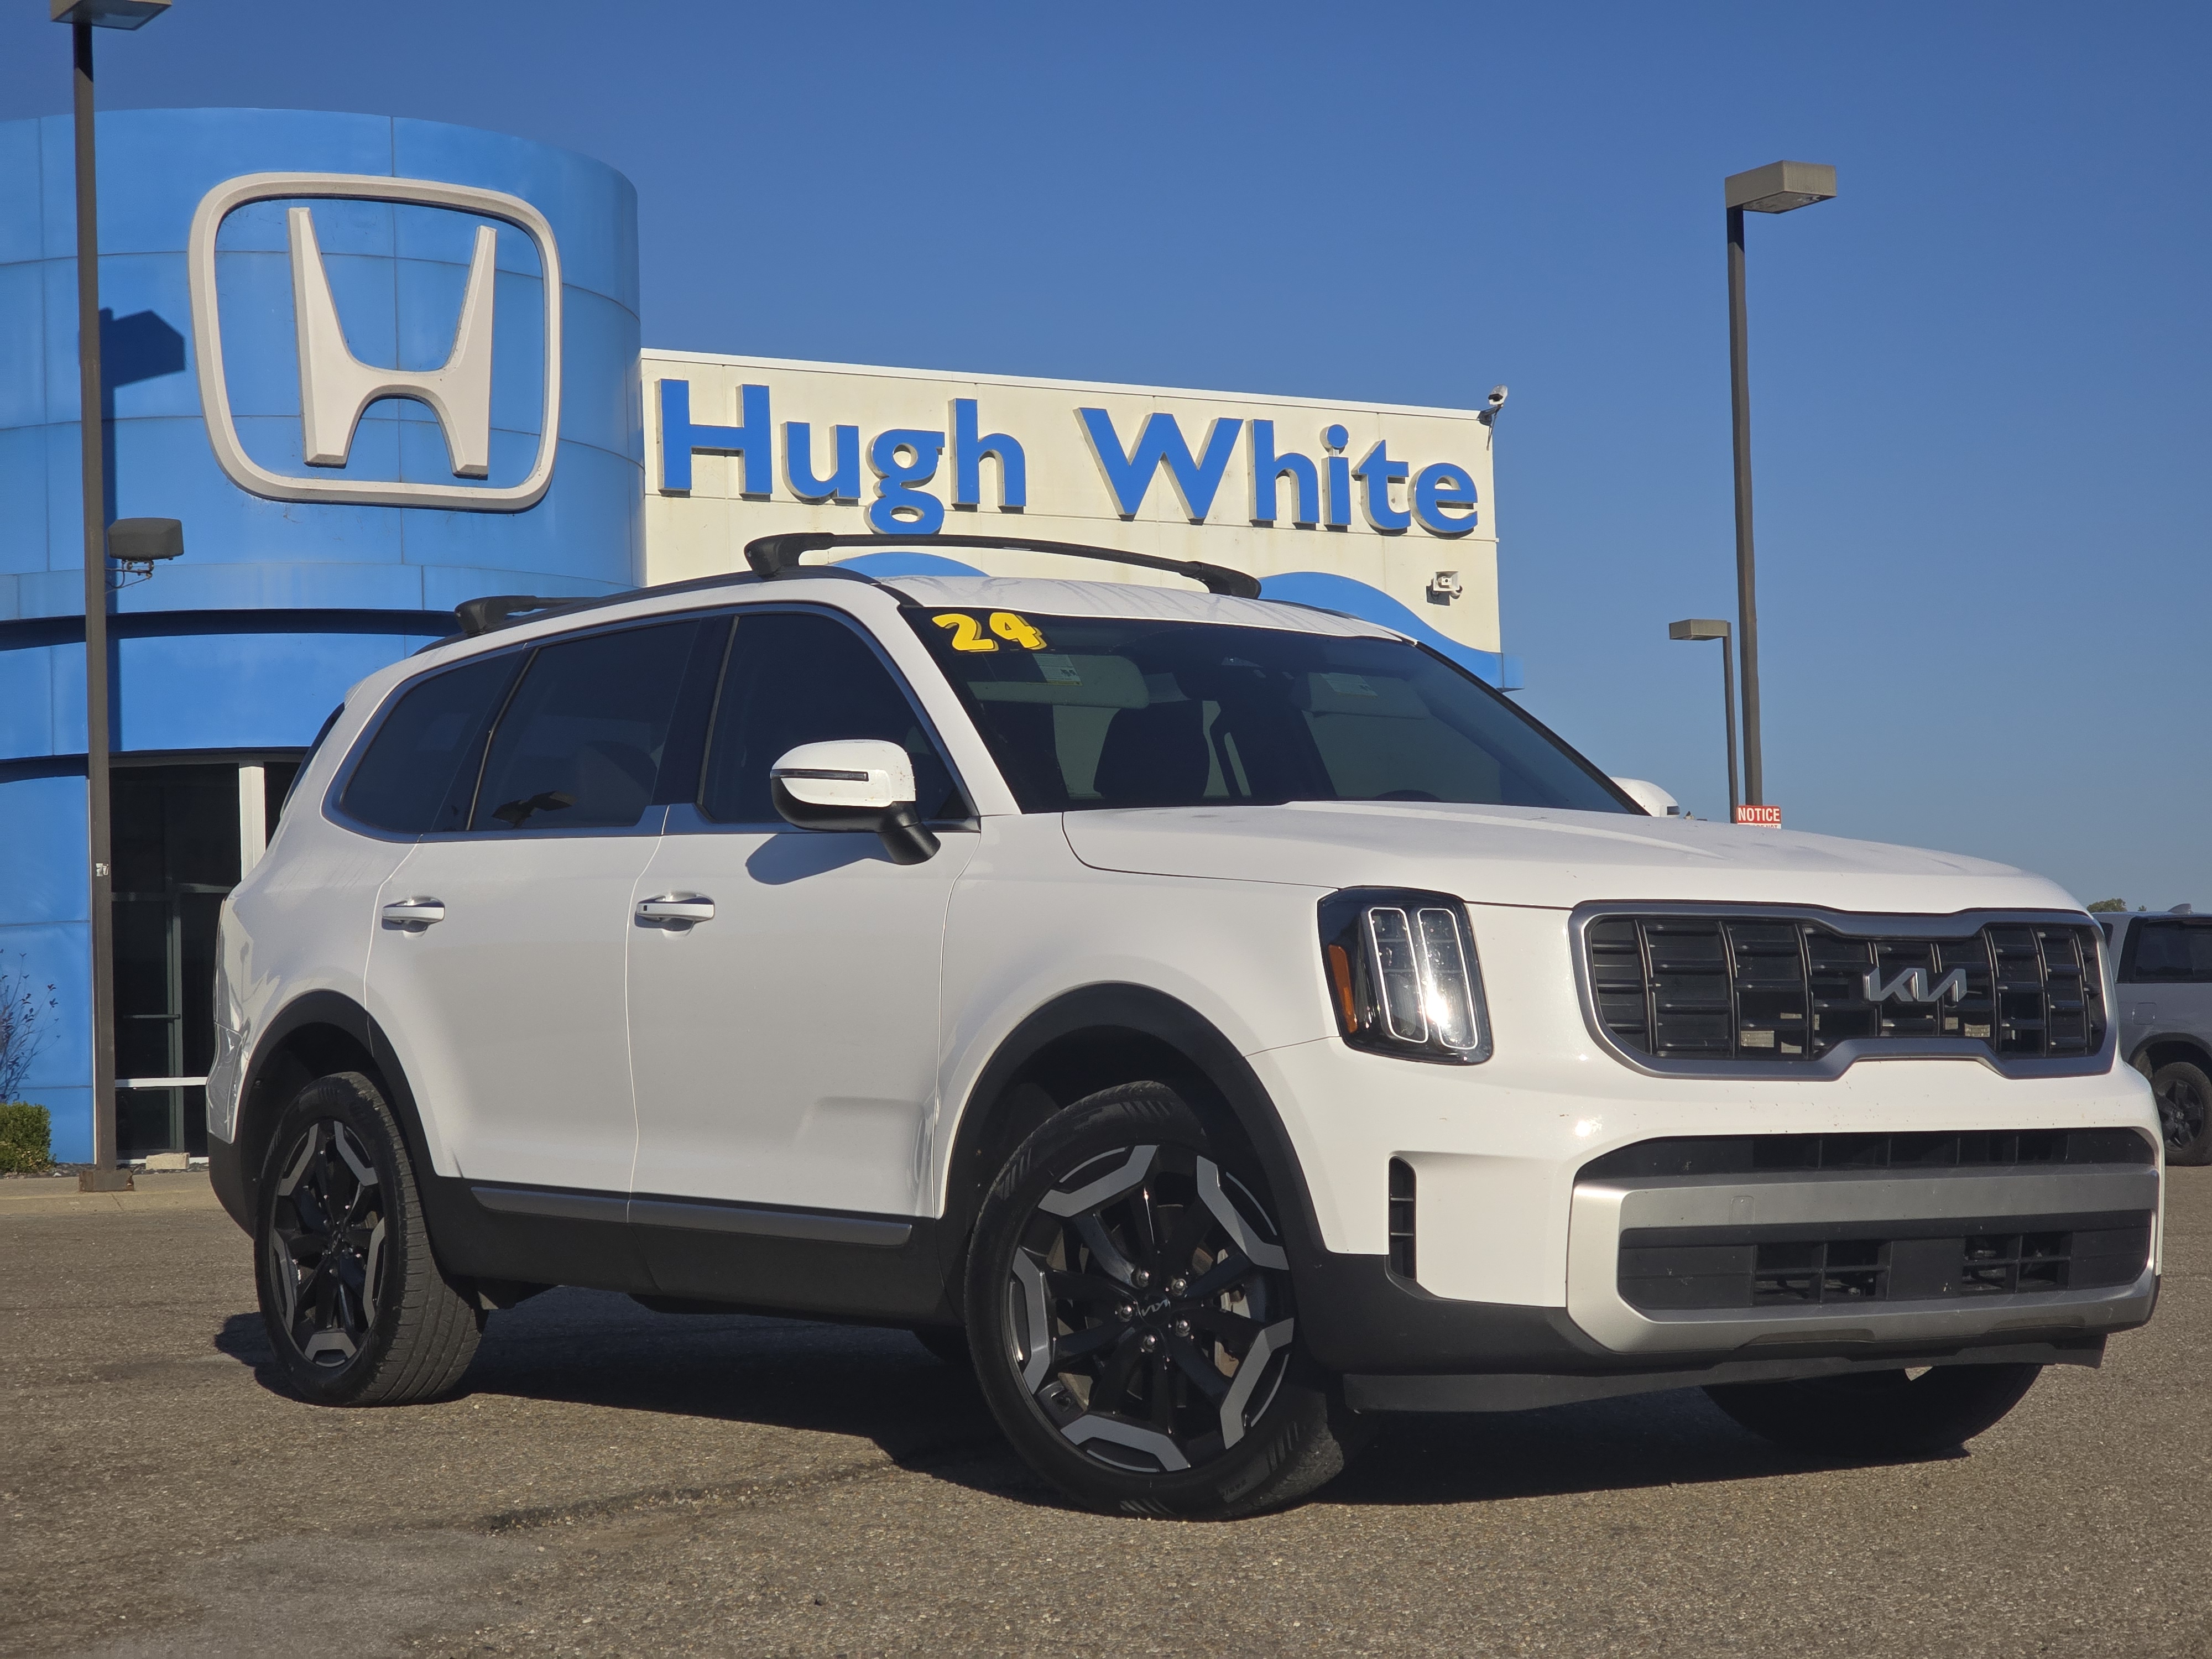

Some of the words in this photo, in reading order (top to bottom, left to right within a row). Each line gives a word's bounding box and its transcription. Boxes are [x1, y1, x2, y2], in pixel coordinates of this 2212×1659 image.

[655, 379, 1026, 535] Hugh
[1073, 407, 1478, 536] White
[932, 612, 1047, 652] 24
[1738, 807, 1780, 821] NOTICE
[1863, 967, 1967, 1003] KIA
